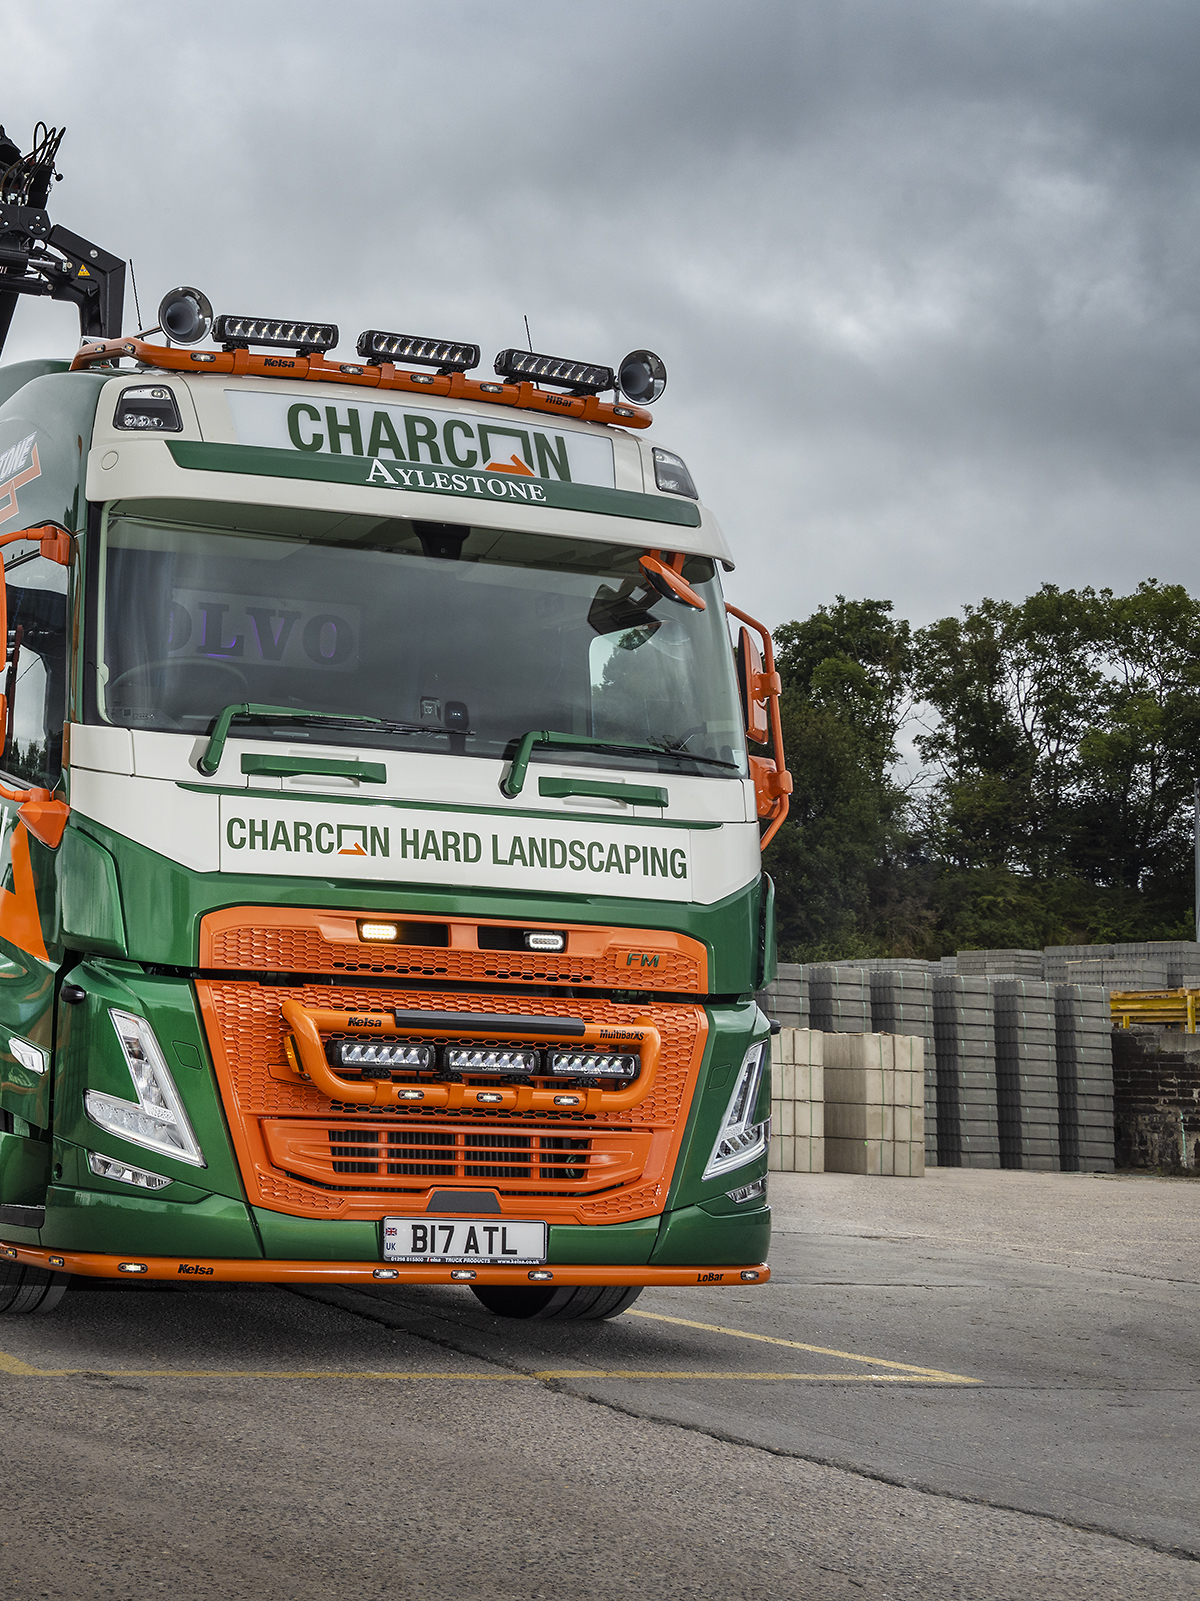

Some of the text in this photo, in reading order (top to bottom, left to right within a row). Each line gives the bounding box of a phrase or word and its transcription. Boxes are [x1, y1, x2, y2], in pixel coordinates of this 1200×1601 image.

[264, 358, 295, 368] Kelsa
[366, 459, 547, 501] AYLESTONE
[226, 817, 688, 879] CHARCON HARD LANDSCAPING
[626, 953, 660, 967] FM
[347, 1017, 382, 1027] Kelsa
[464, 1226, 518, 1254] ATL
[178, 1263, 214, 1275] Kelsa
[697, 1273, 724, 1282] LoBar
